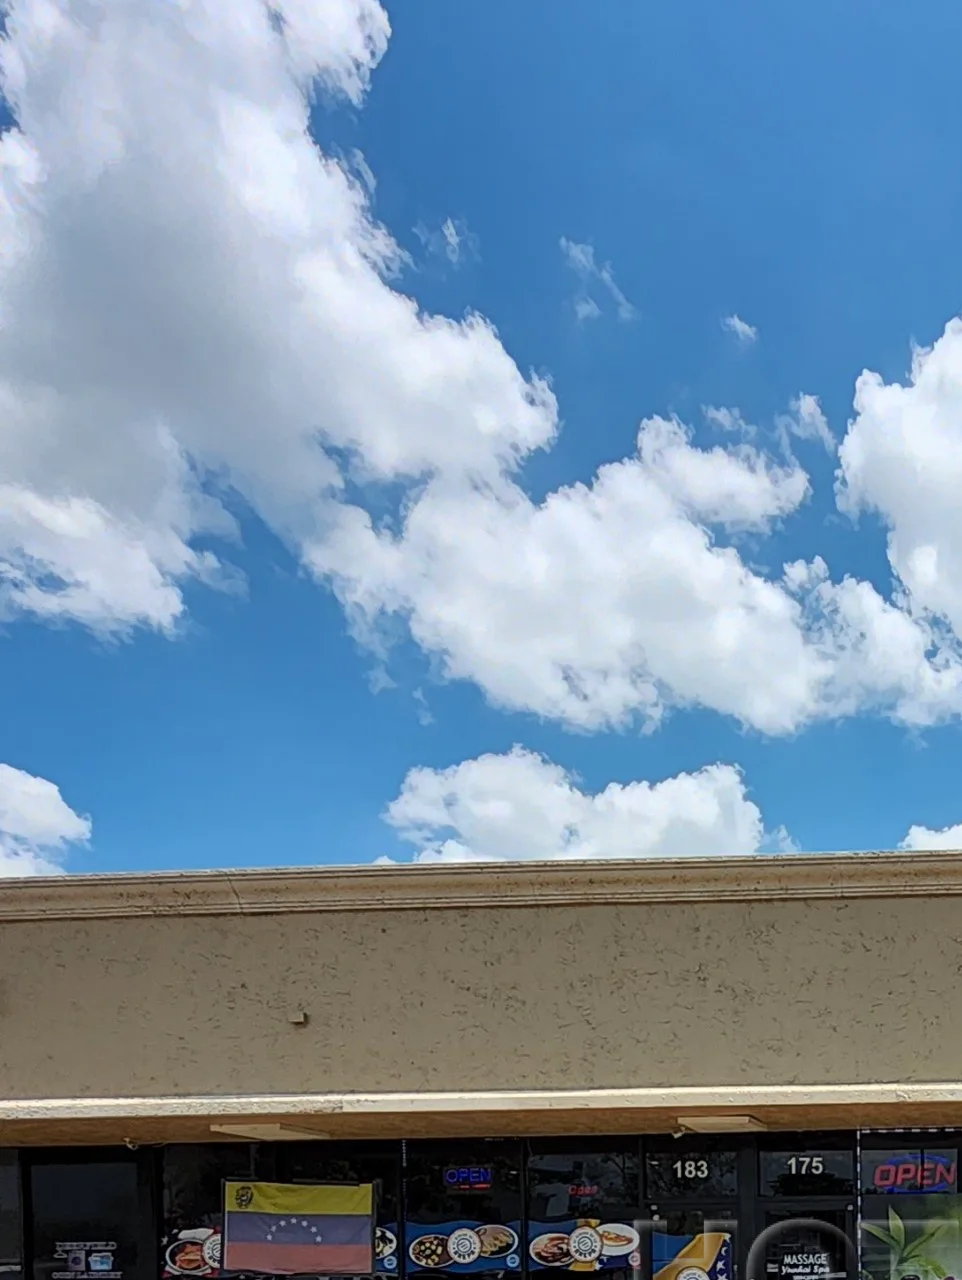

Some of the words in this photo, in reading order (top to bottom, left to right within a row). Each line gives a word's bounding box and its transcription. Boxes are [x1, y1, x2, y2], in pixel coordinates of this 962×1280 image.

[446, 1167, 492, 1183] OPEN
[673, 1160, 709, 1179] 183
[787, 1157, 823, 1175] 175
[874, 1161, 957, 1187] OPEN
[783, 1253, 828, 1265] MASSAGE
